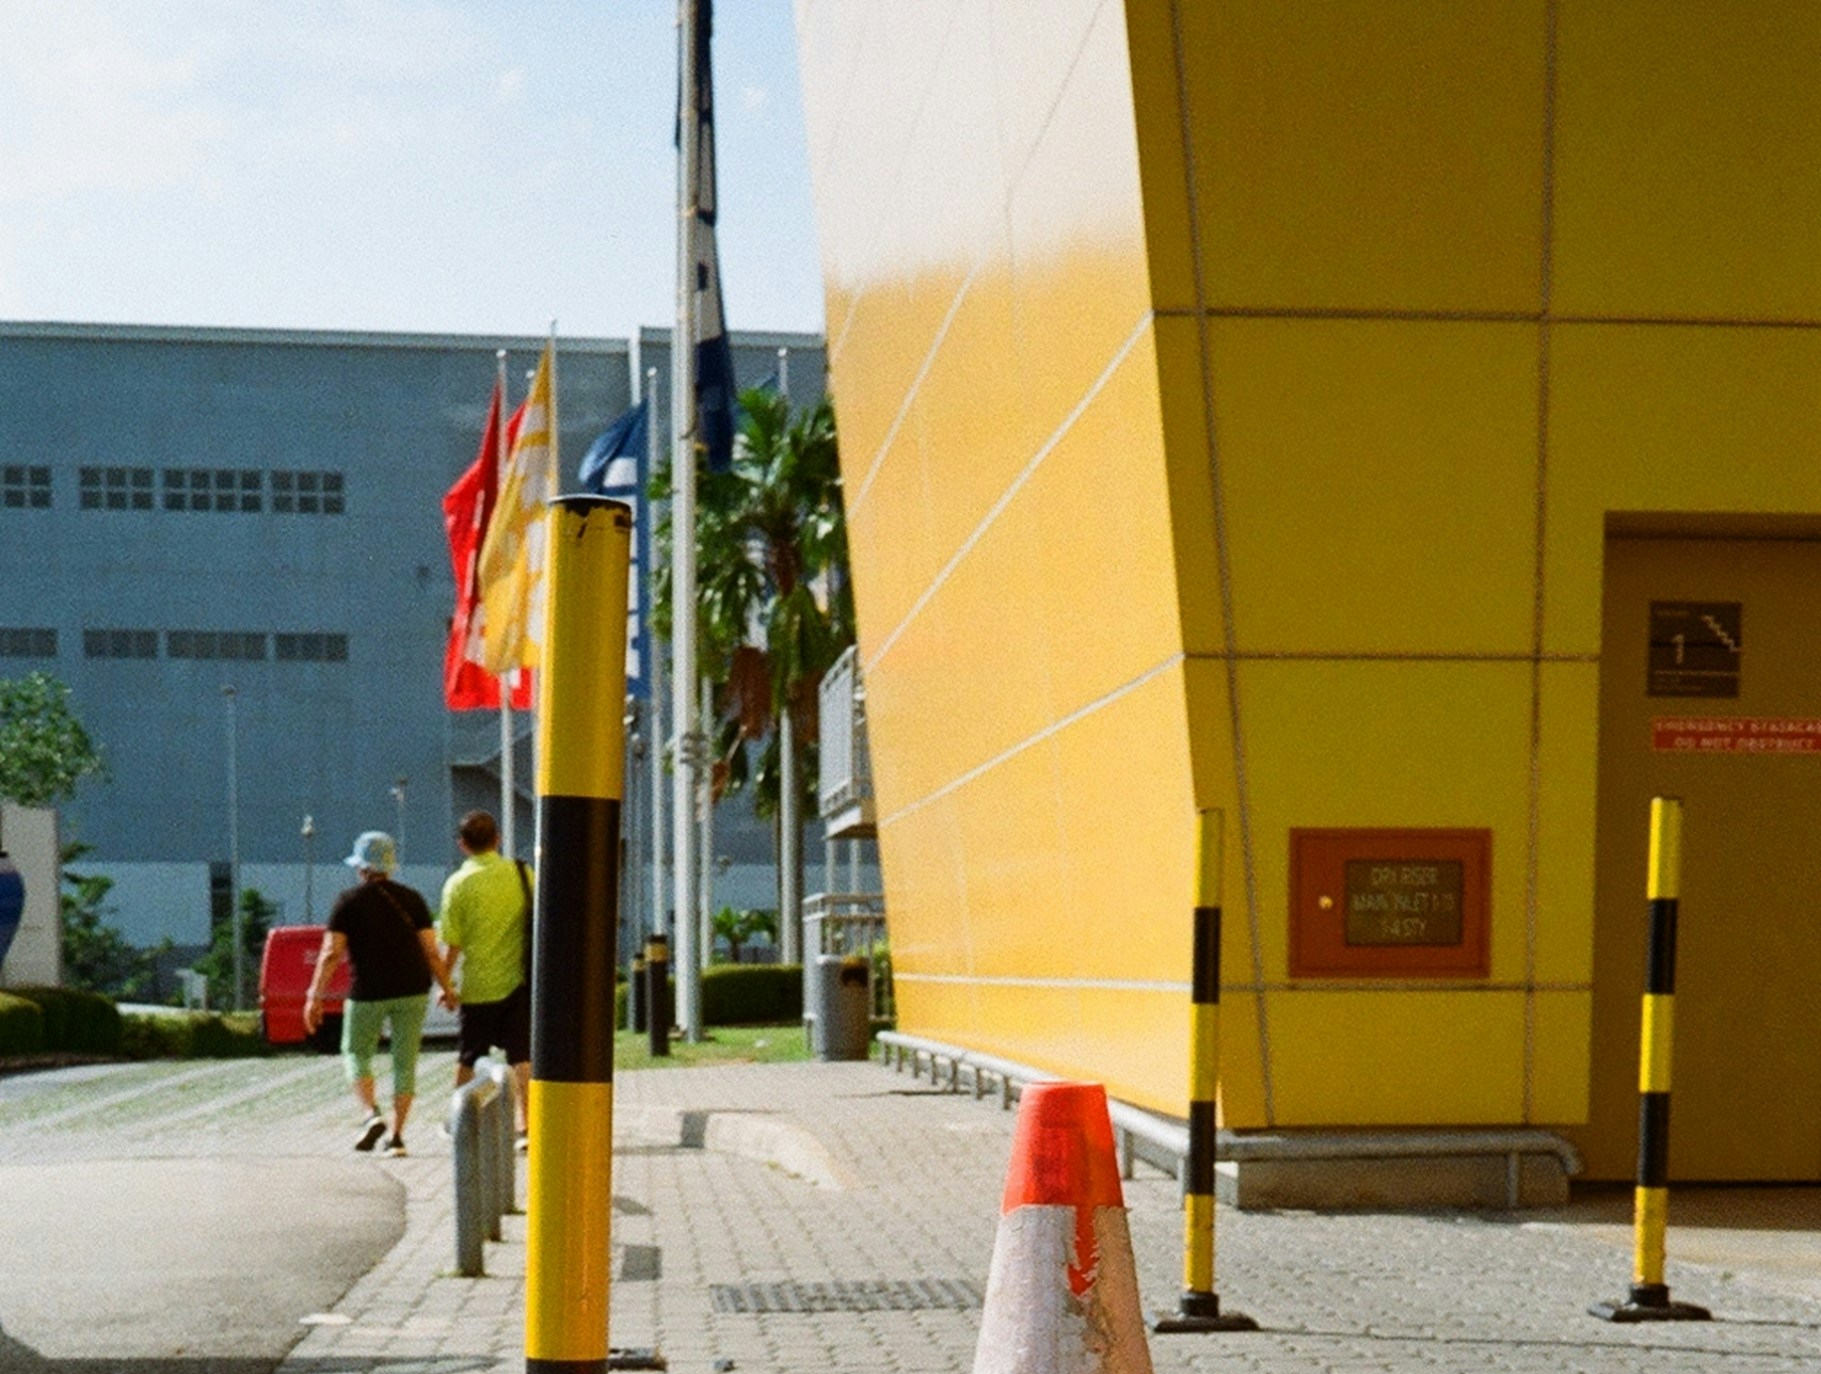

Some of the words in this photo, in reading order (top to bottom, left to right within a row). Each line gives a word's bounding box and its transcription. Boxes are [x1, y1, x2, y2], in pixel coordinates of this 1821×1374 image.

[1674, 736, 1696, 749] DO
[1701, 736, 1731, 749] NOT
[1736, 736, 1814, 749] OBSTRUCT
